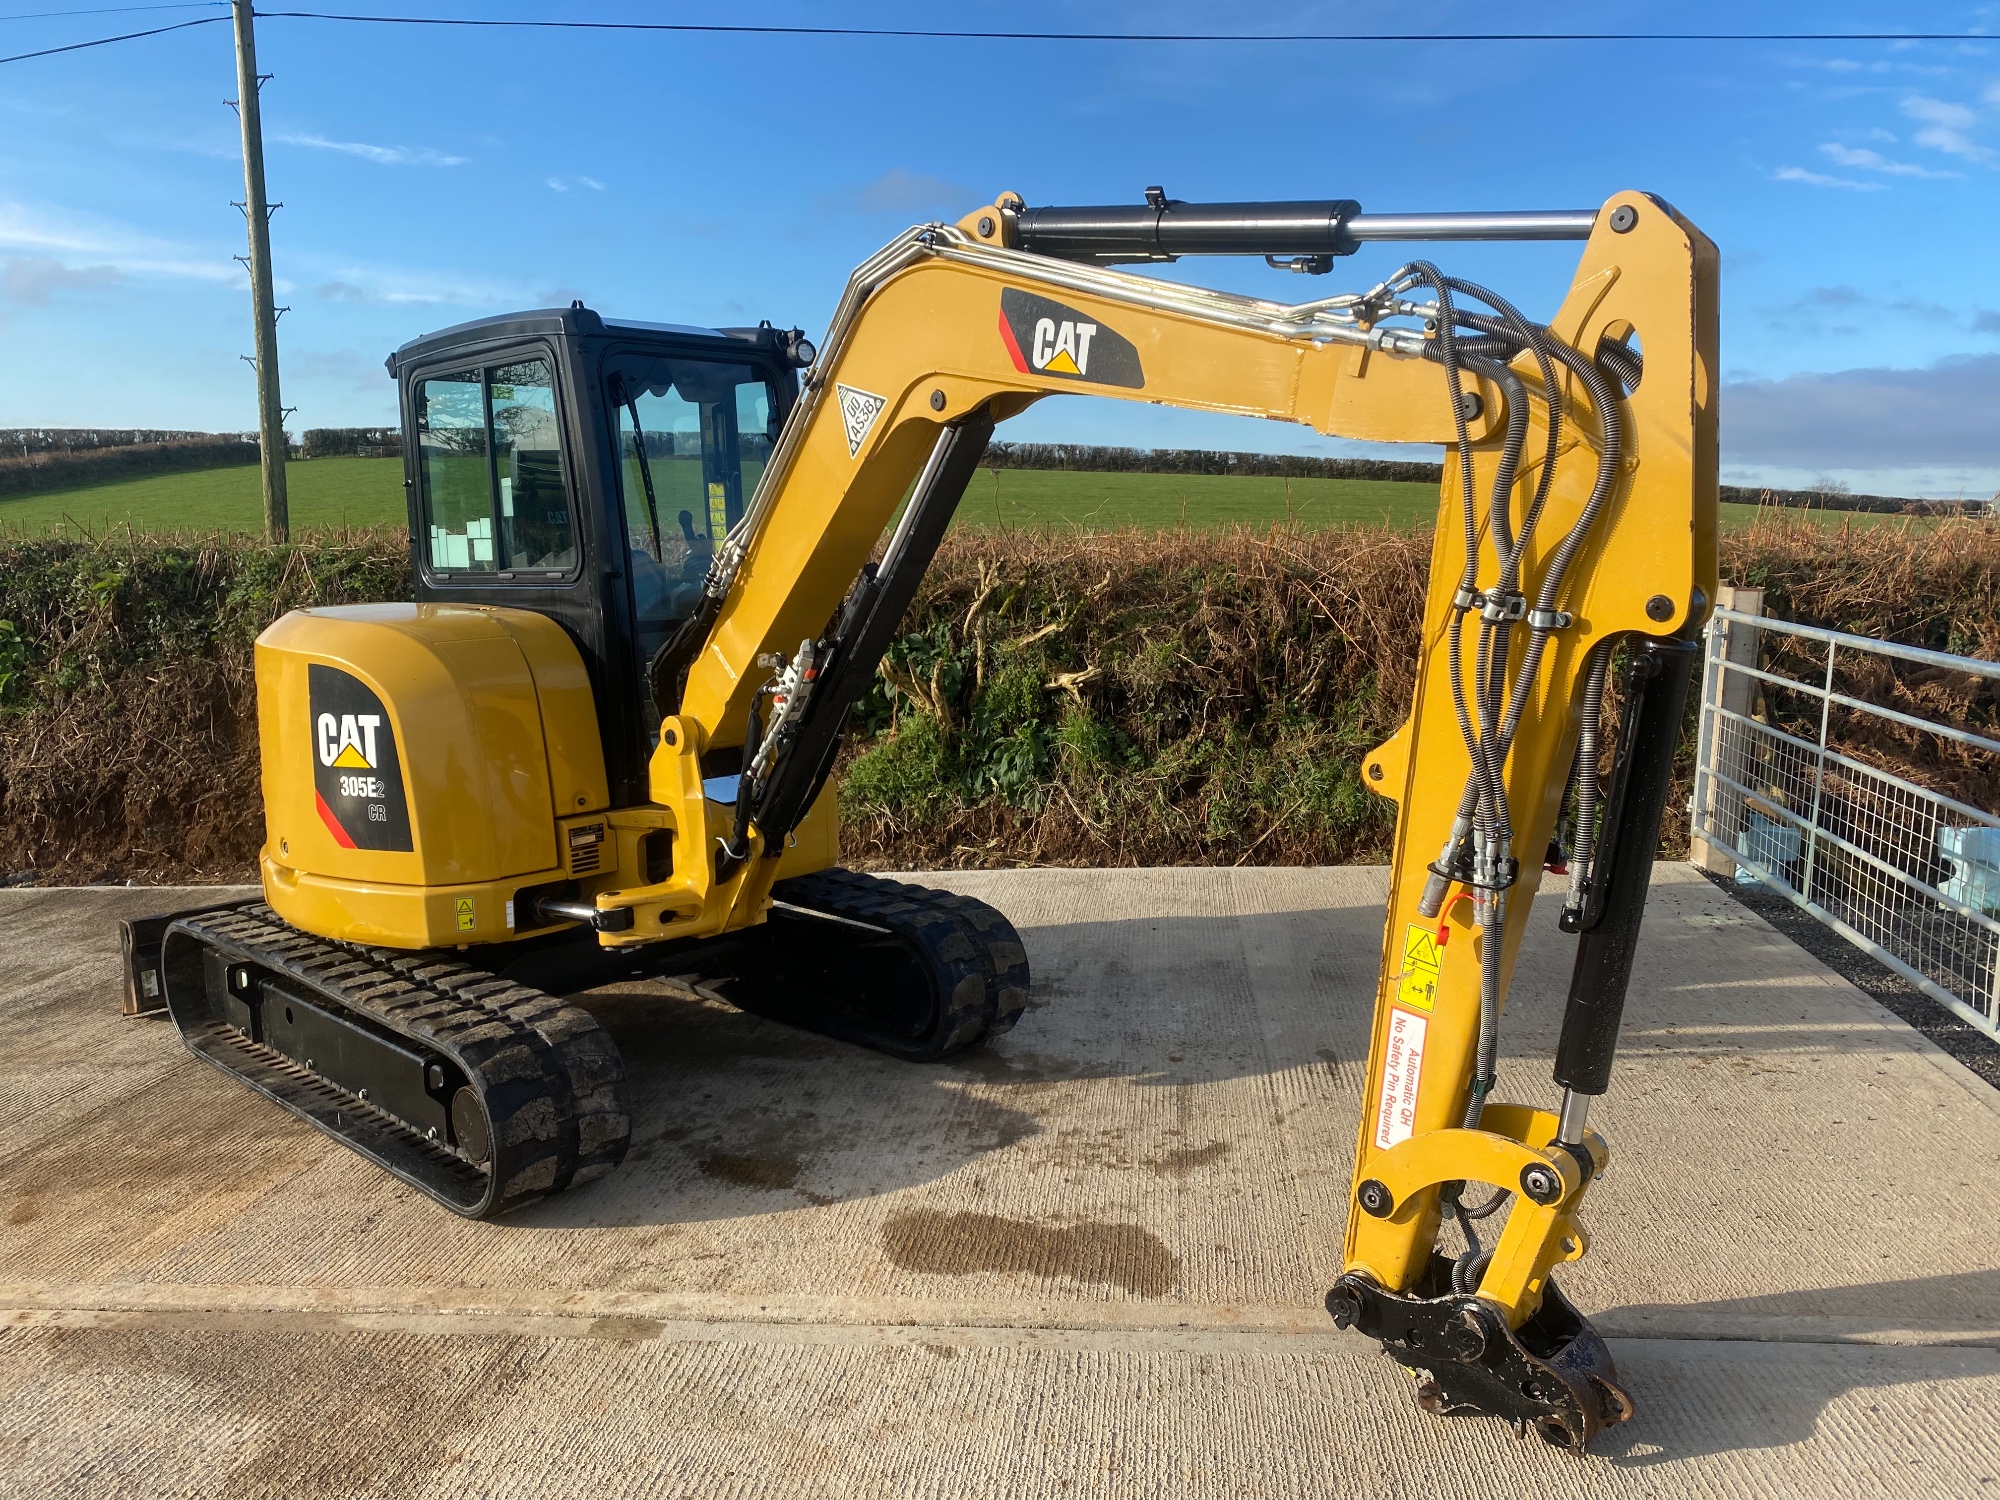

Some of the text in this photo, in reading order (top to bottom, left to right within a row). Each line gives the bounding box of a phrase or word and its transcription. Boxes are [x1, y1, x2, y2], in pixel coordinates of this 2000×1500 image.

[1032, 317, 1097, 375] CAT
[547, 510, 568, 525] CAT
[317, 712, 381, 769] CAT
[339, 776, 385, 798] 305E2
[367, 804, 387, 822] CR
[1380, 1016, 1407, 1145] No Safety Pin Required
[1400, 1047, 1421, 1127] Automatic QH
